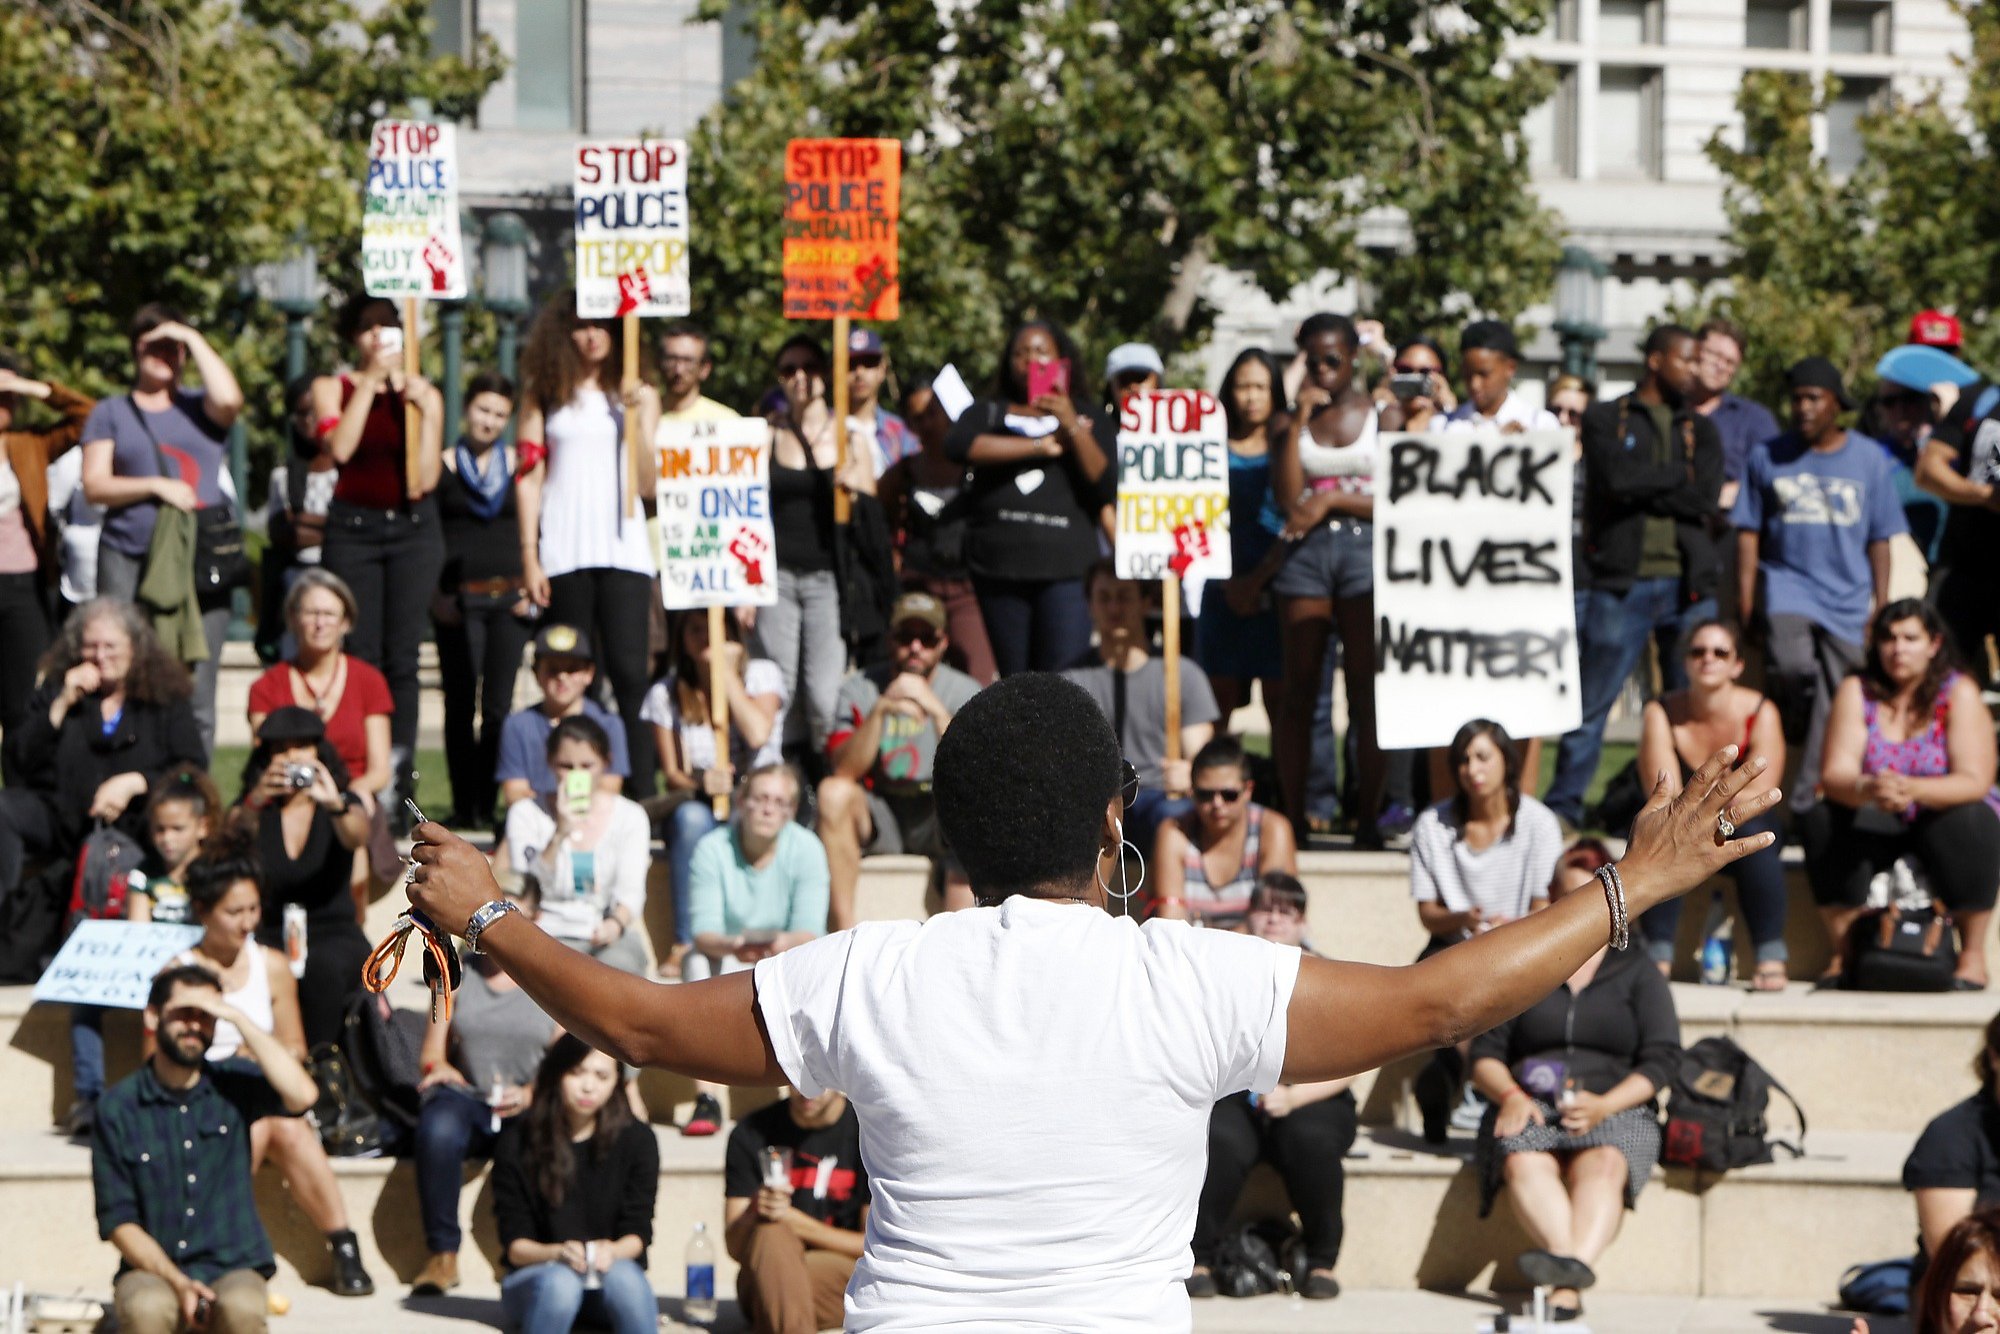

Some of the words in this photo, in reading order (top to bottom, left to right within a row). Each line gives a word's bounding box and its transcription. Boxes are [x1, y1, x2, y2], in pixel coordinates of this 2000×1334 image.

[374, 125, 440, 158] STOP
[367, 159, 446, 189] POLICE
[579, 146, 677, 184] STOP
[792, 145, 880, 178] STOP
[578, 190, 679, 231] POLICE
[784, 180, 885, 213] POLICE
[1120, 389, 1217, 434] STOP
[1118, 440, 1222, 483] POLICE
[1388, 440, 1560, 505] BLACK
[664, 492, 688, 509] TO
[701, 485, 764, 519] ONE
[1117, 491, 1230, 533] TERROR
[1385, 526, 1562, 588] LIVES
[690, 567, 735, 592] ALL
